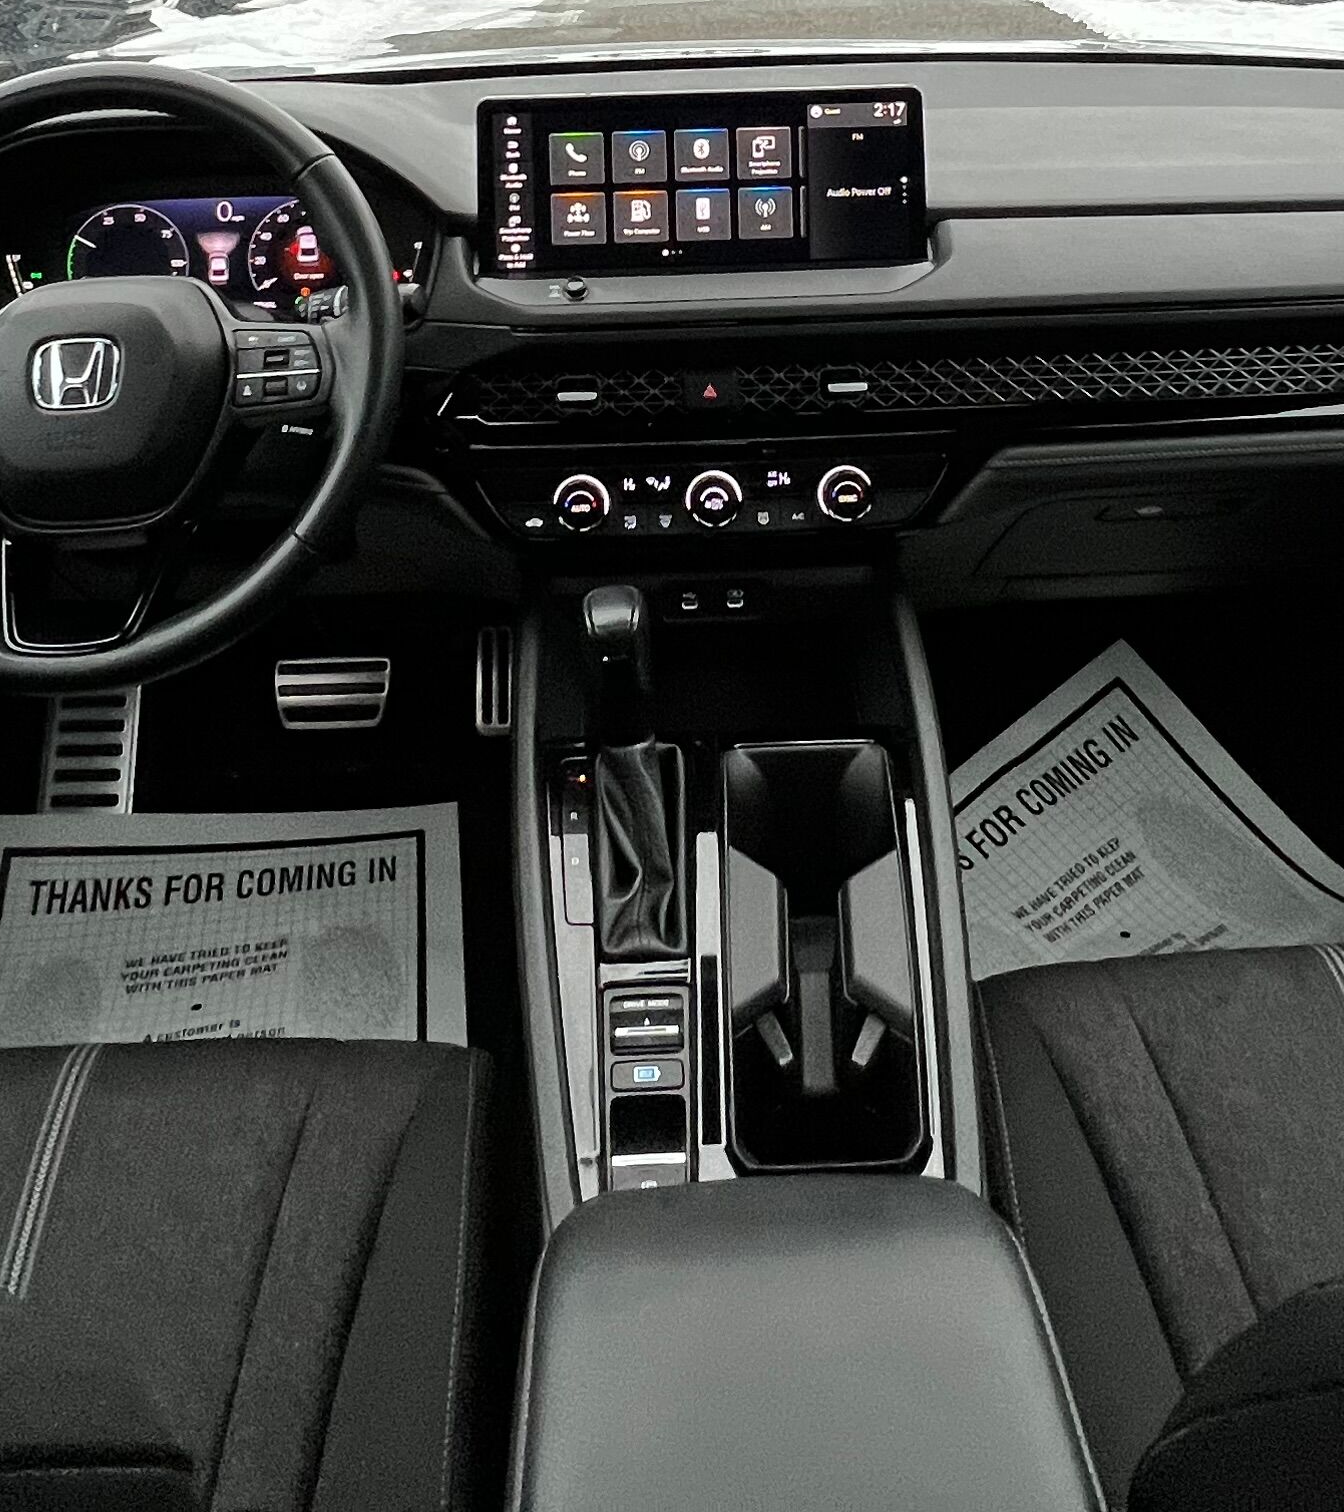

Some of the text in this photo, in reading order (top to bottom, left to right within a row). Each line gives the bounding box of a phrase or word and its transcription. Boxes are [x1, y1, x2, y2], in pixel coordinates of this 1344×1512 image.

[873, 101, 906, 118] 2:17
[826, 186, 892, 198] Audio Power Off
[965, 714, 1140, 860] FOR COMING IN
[29, 855, 397, 916] THANKS FOR COMING IN
[1053, 862, 1086, 891] TRIED
[1082, 853, 1100, 868] TO
[1024, 850, 1136, 932] YOUR CARPETING CLEAN
[1068, 903, 1096, 927] THIS
[1092, 881, 1126, 909] PAPER
[120, 950, 288, 982] YOUR CARPETING CLEAN
[150, 951, 187, 966] HAVE
[190, 947, 230, 960] TRIED
[234, 943, 251, 955] TO
[255, 938, 288, 952] KEEP
[125, 962, 278, 994] WITH THIS PAPER MAT
